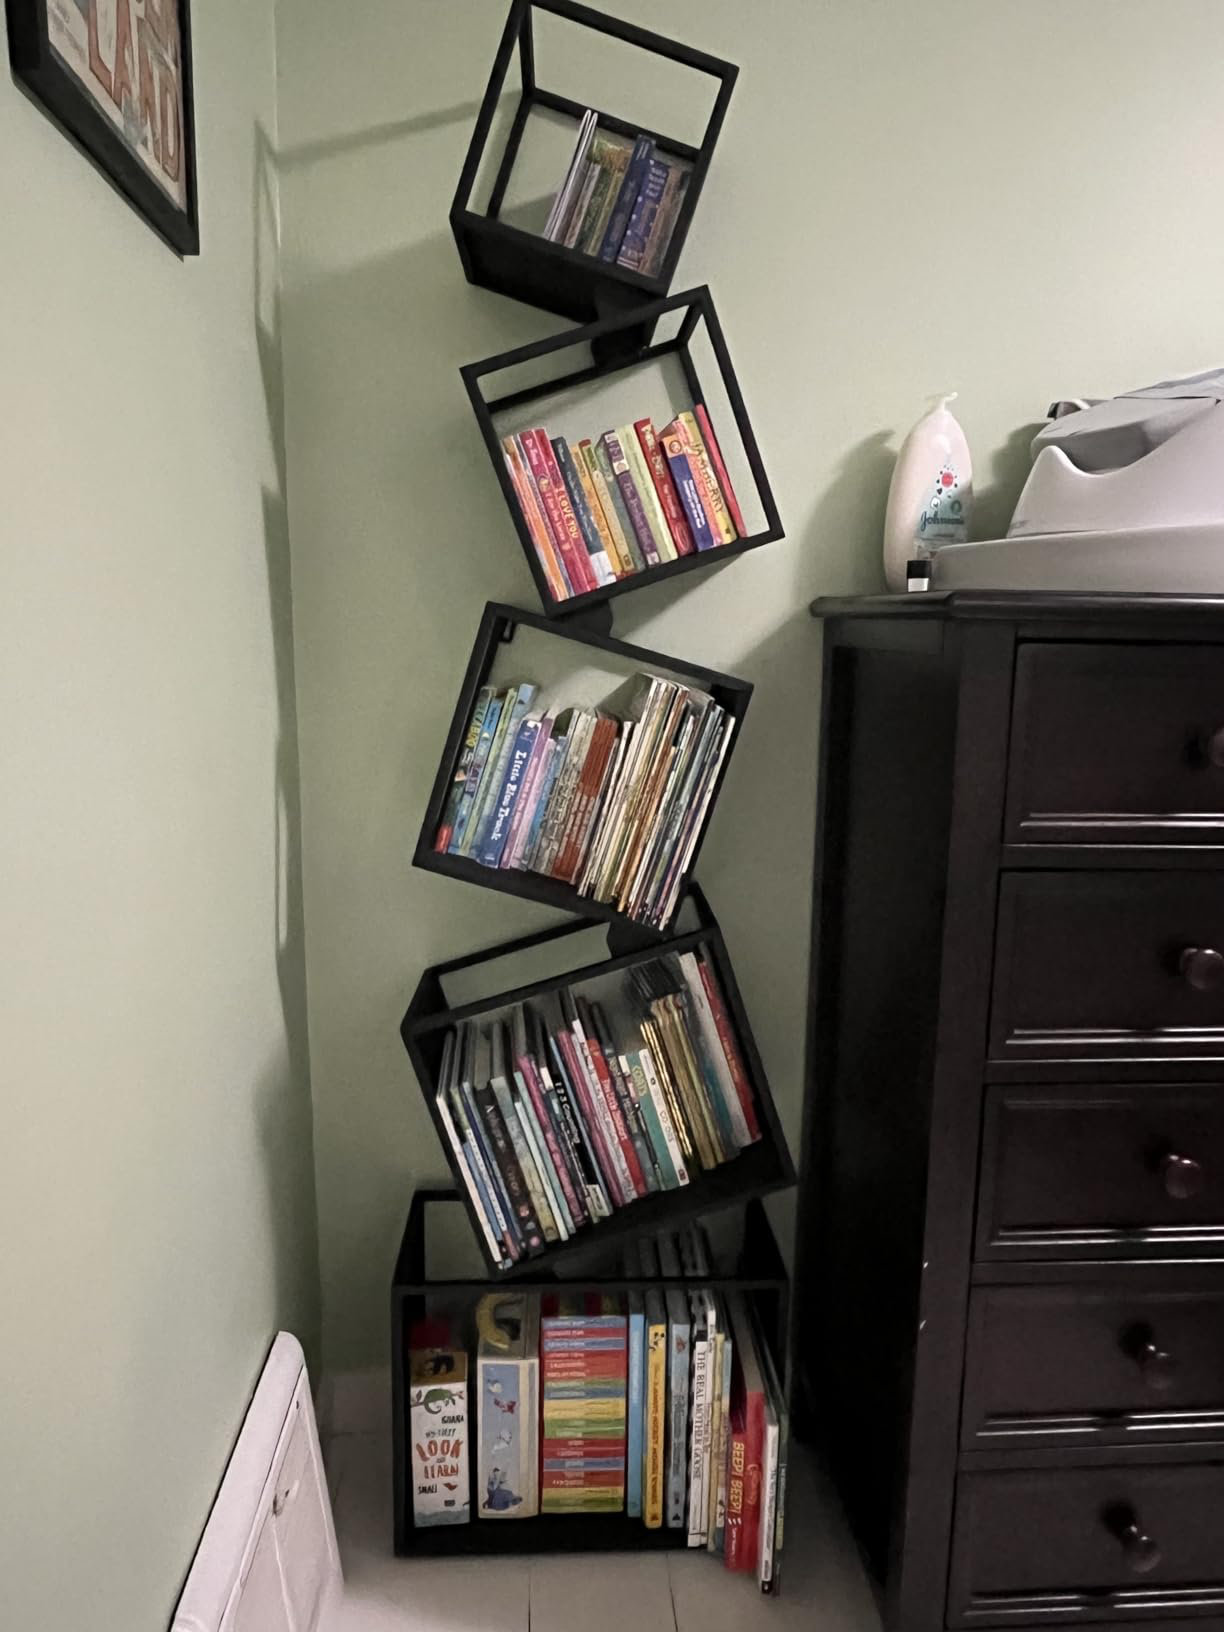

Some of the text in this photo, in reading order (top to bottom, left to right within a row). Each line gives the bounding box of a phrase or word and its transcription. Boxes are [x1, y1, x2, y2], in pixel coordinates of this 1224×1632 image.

[693, 442, 724, 513] JAMBERRY
[558, 494, 573, 520] LOVE
[567, 520, 578, 539] YOU
[510, 750, 527, 781] Little
[503, 783, 518, 806] Blue
[491, 807, 510, 841] Truck
[696, 1350, 705, 1370] THE
[694, 1403, 703, 1445] MOTHER
[416, 1438, 464, 1462] LOOK
[692, 1447, 702, 1480] GOOSE
[731, 1441, 744, 1475] BEEP!
[728, 1478, 743, 1513] BEEP!
